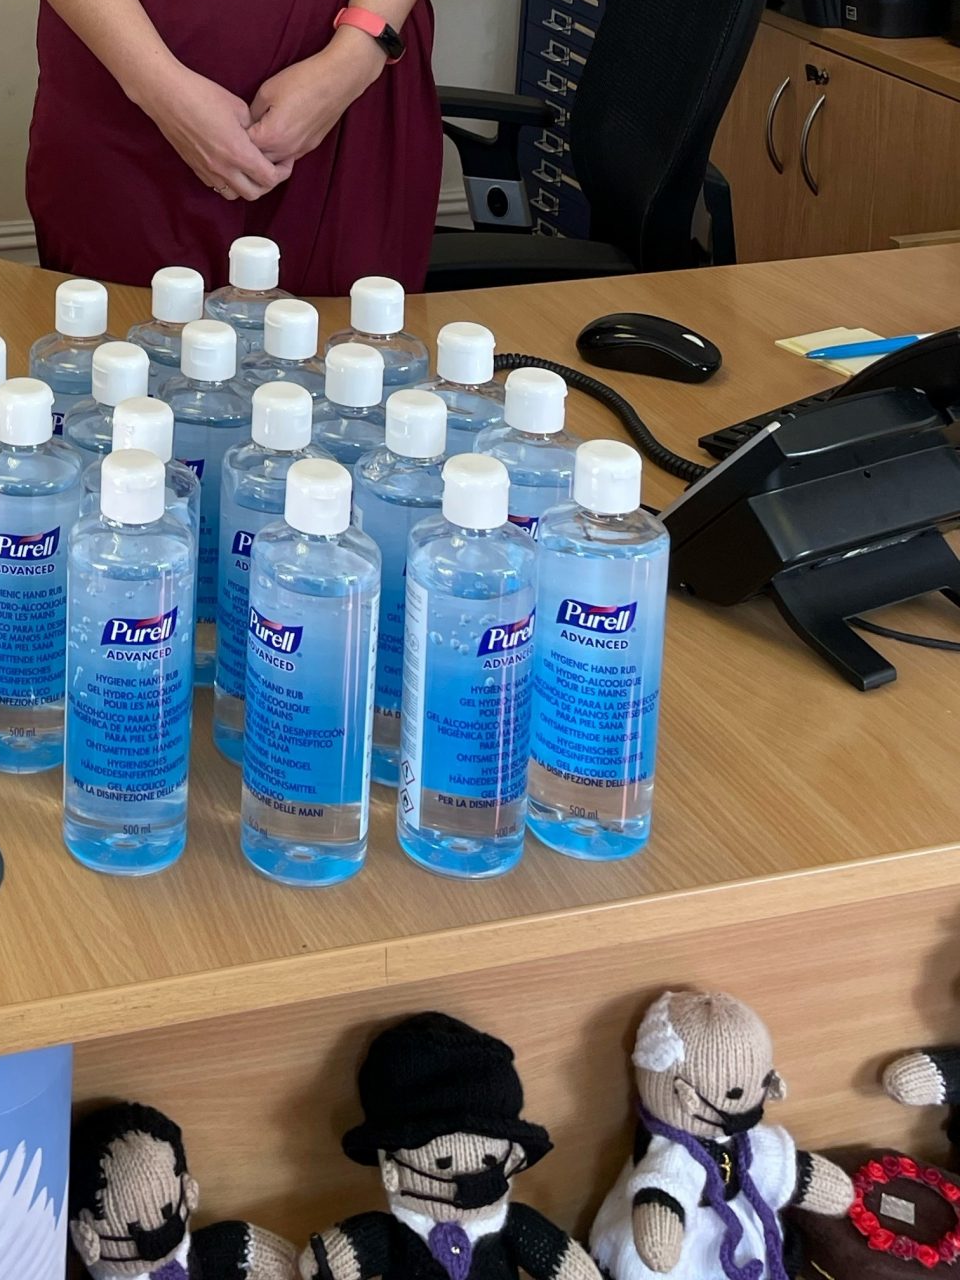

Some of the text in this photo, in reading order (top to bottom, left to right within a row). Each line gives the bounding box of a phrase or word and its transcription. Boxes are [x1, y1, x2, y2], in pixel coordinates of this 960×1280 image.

[22, 590, 48, 600] HAND
[14, 612, 28, 620] LES
[564, 600, 630, 631] Purell
[110, 616, 172, 642] Purell
[250, 608, 296, 653] Purell
[560, 630, 629, 650] ADVANCED
[106, 647, 172, 662] ADVANCED
[550, 650, 589, 672] HYGIENIC
[591, 664, 618, 676] HAND
[96, 672, 137, 688] HYGIENIC
[166, 670, 179, 682] RUB
[87, 683, 100, 695] GEL
[262, 676, 304, 700] HAND RUB
[556, 676, 628, 698] POUR LES MAINS
[104, 698, 144, 710] POUR LES
[460, 698, 476, 708] GEL
[578, 698, 614, 711] PARA LA
[266, 702, 294, 722] MAINS
[574, 708, 609, 720] MANOS
[578, 718, 596, 729] PIEL
[598, 722, 624, 730] SANA
[9, 727, 24, 738] 500
[270, 752, 312, 771] HANDGEL
[546, 764, 604, 788] DISINFEZIONE
[572, 766, 616, 778] ALCOLICO
[86, 786, 95, 796] LA
[96, 790, 154, 802] DISINFEZIONE
[156, 785, 175, 800] DELLE
[107, 781, 123, 792] GEL
[438, 794, 467, 808] PER LA
[273, 800, 324, 818] DELLE MANI
[570, 804, 586, 818] 500
[122, 824, 140, 835] 500
